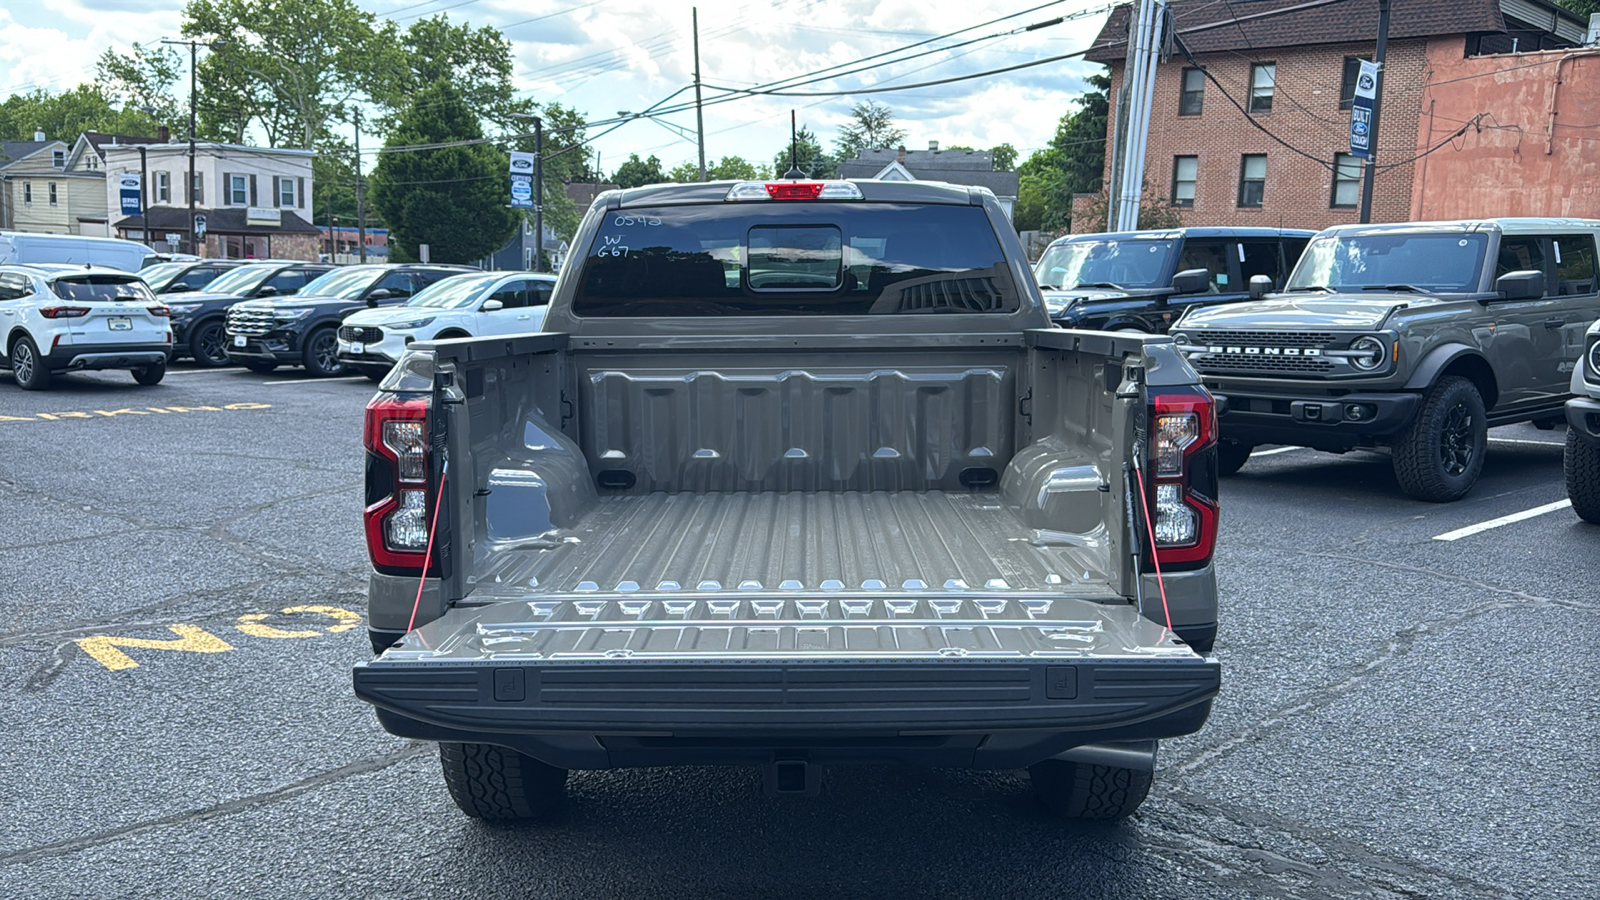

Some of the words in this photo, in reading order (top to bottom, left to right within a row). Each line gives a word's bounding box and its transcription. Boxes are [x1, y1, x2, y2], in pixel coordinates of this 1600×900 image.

[1353, 109, 1370, 123] BUILT
[1352, 134, 1368, 146] TOUGH
[614, 215, 663, 227] 0542
[1209, 346, 1320, 356] BRONCO
[74, 605, 363, 672] NO
